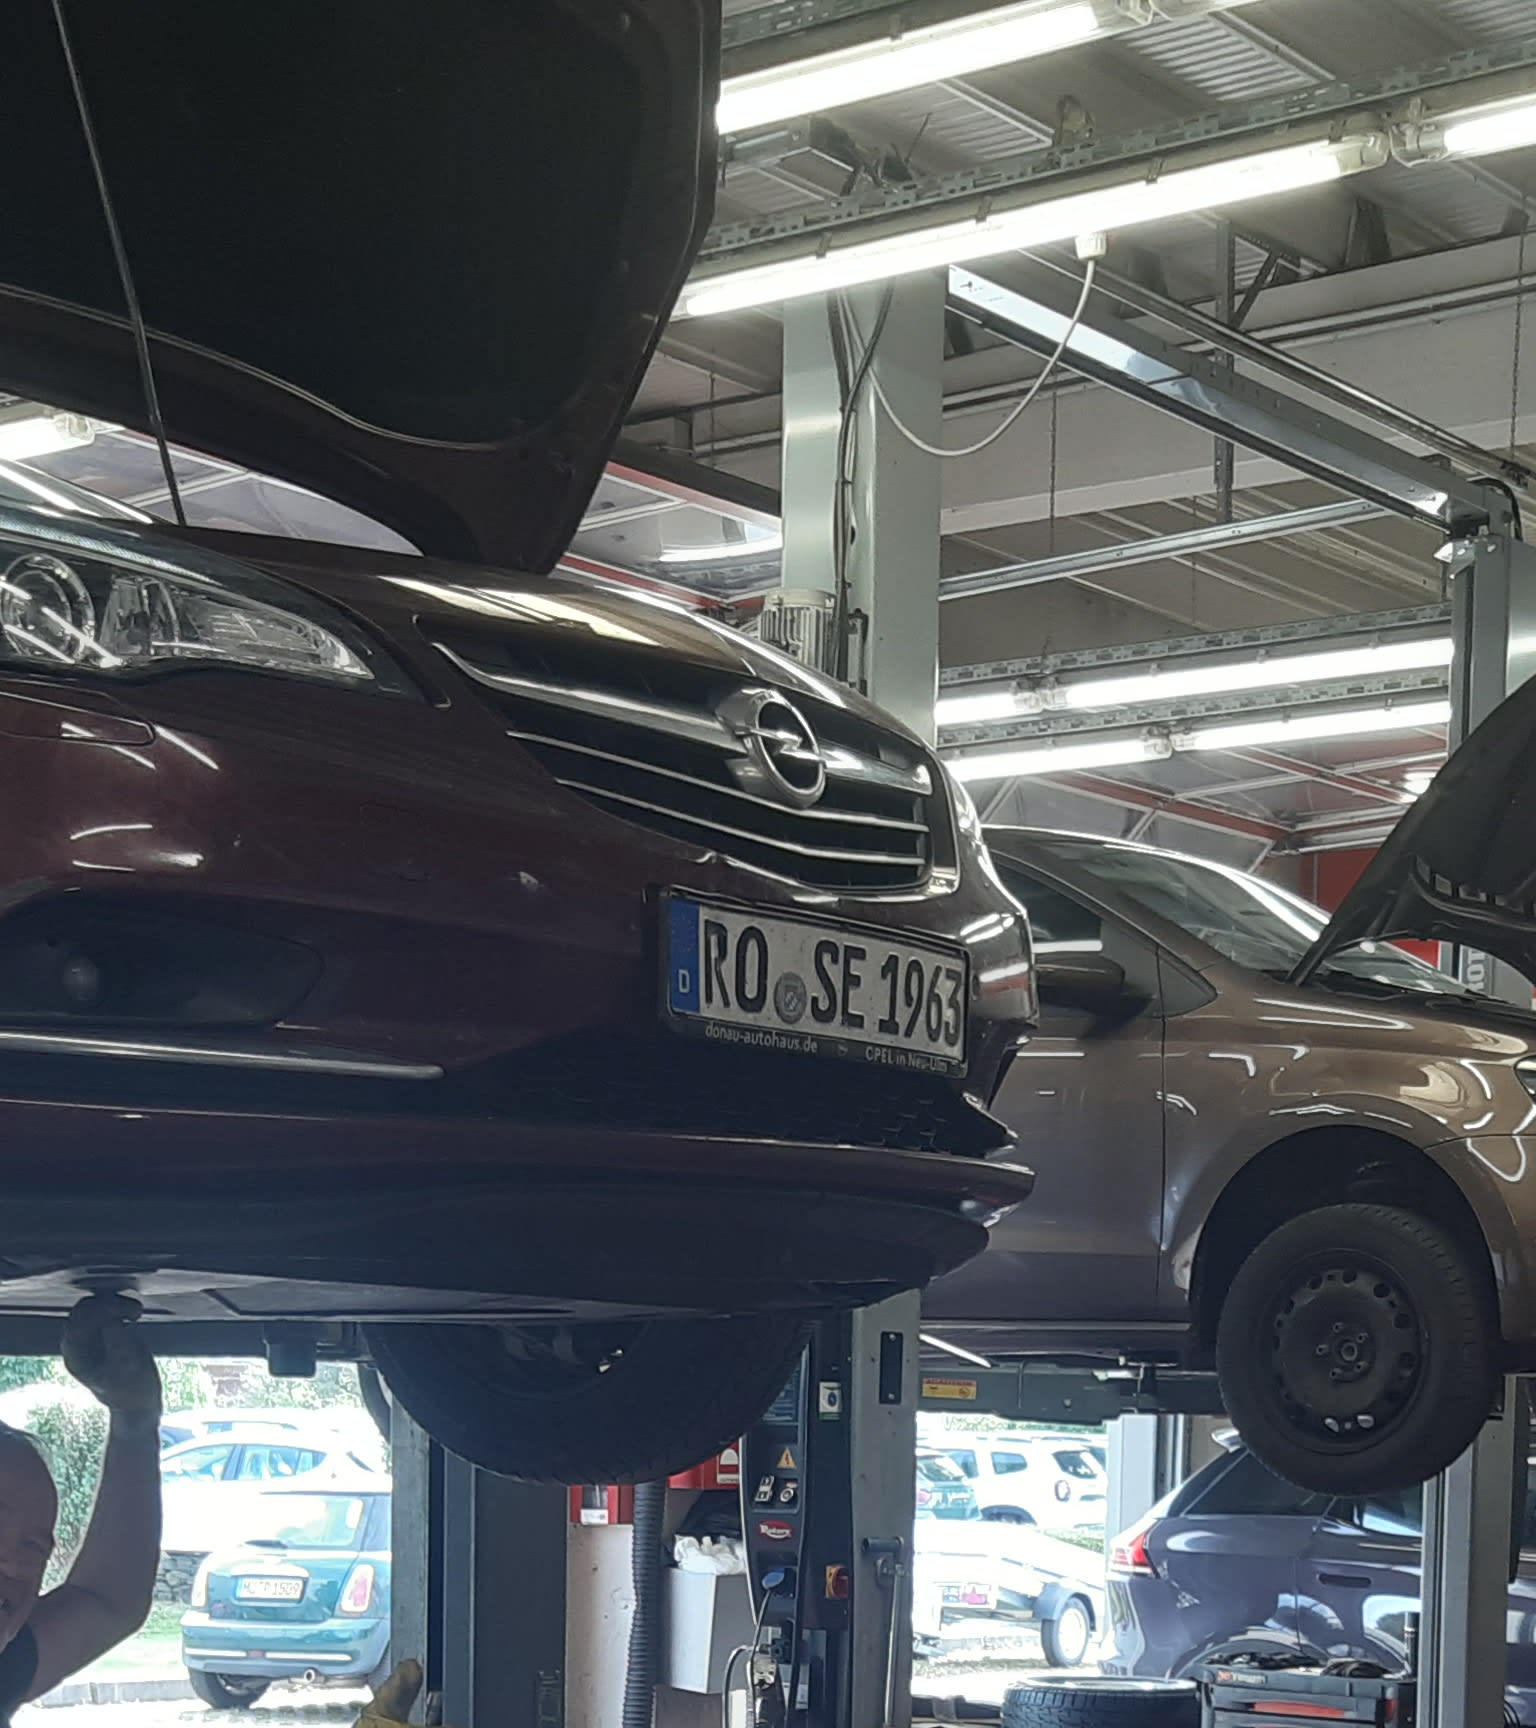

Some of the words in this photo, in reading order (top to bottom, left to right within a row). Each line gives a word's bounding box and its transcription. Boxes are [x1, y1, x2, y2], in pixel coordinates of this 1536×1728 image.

[677, 969, 691, 994] D
[703, 918, 769, 1013] RO
[810, 939, 867, 1028] SE
[877, 953, 964, 1047] 1963
[704, 1021, 818, 1054] donau-autohaus.de
